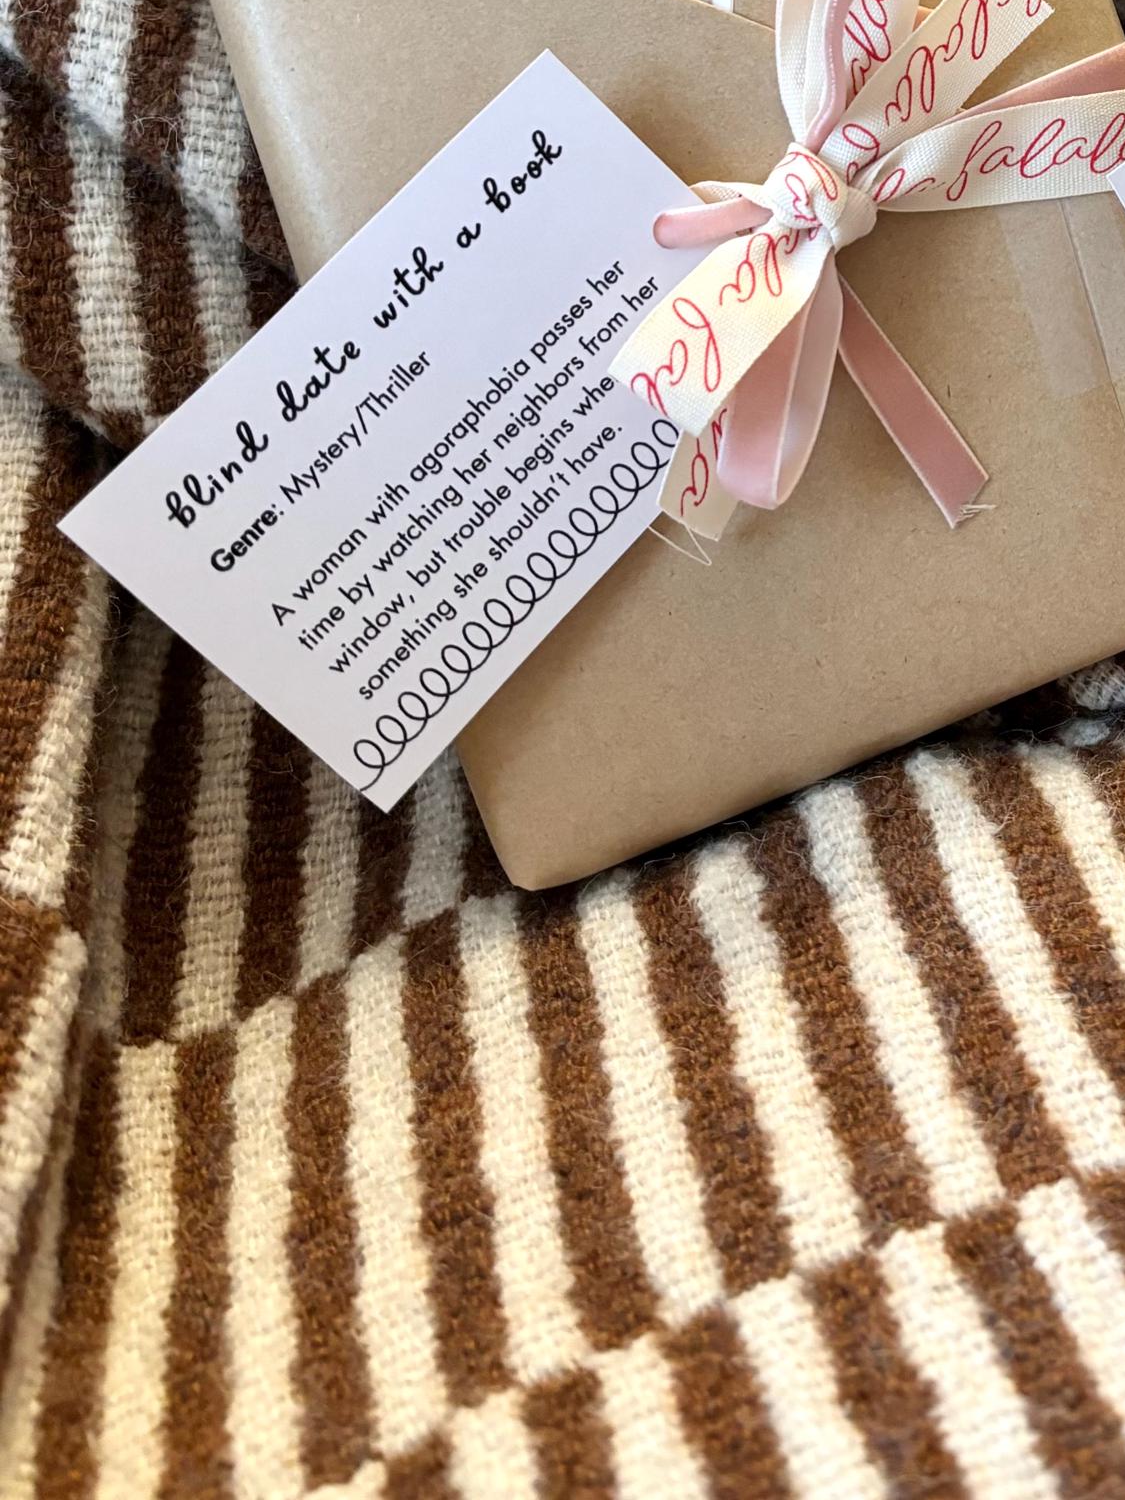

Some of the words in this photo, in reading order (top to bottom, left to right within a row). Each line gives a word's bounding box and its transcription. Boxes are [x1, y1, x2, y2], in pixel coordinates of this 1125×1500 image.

[165, 420, 269, 529] blind
[275, 340, 361, 423] date
[372, 246, 444, 329] with
[456, 222, 482, 249] a
[482, 129, 563, 214] book
[210, 503, 285, 573] Genre:
[279, 351, 431, 505] Mystery/Thriller
[271, 603, 296, 627] A
[292, 528, 368, 601] woman
[364, 483, 411, 525] with
[409, 358, 531, 483] agoraphobia
[529, 295, 593, 365] passes
[585, 260, 625, 296] her
[297, 605, 346, 651] time
[337, 573, 375, 605] by
[371, 484, 464, 573] watching
[452, 448, 492, 485] her
[492, 356, 585, 450] neighbors
[578, 312, 629, 357] from
[620, 276, 659, 312] her
[328, 592, 416, 673] window,
[405, 549, 447, 588] but
[442, 484, 512, 553] trouble
[504, 418, 575, 485] begins
[572, 376, 618, 417] whe
[358, 598, 458, 701] something
[453, 562, 489, 599] she
[488, 472, 571, 562] shouldn't
[562, 426, 623, 475] have.
